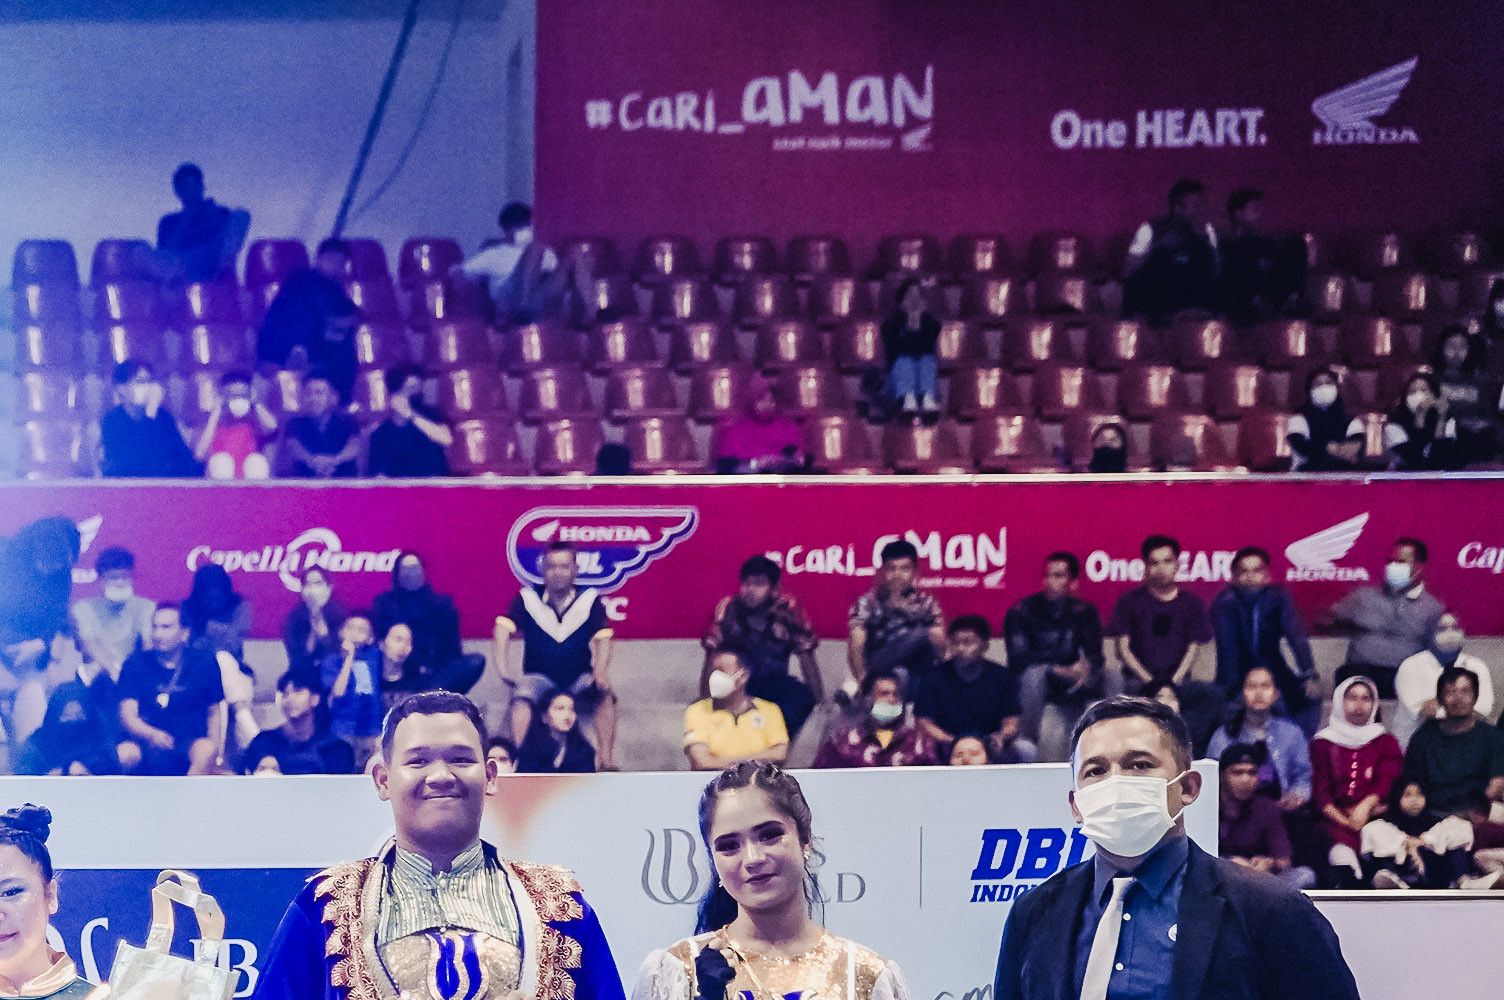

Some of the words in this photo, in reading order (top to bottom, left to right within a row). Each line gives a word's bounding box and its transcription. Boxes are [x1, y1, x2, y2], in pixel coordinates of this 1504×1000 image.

[1050, 109, 1127, 149] One
[1135, 107, 1268, 149] HEART.
[1312, 127, 1419, 145] HONDA
[558, 526, 652, 542] HONDA
[303, 549, 402, 573] Hond
[1085, 550, 1145, 582] One
[1175, 550, 1237, 582] EAR
[1458, 542, 1504, 574] Cap
[1285, 566, 1370, 582] HONDA
